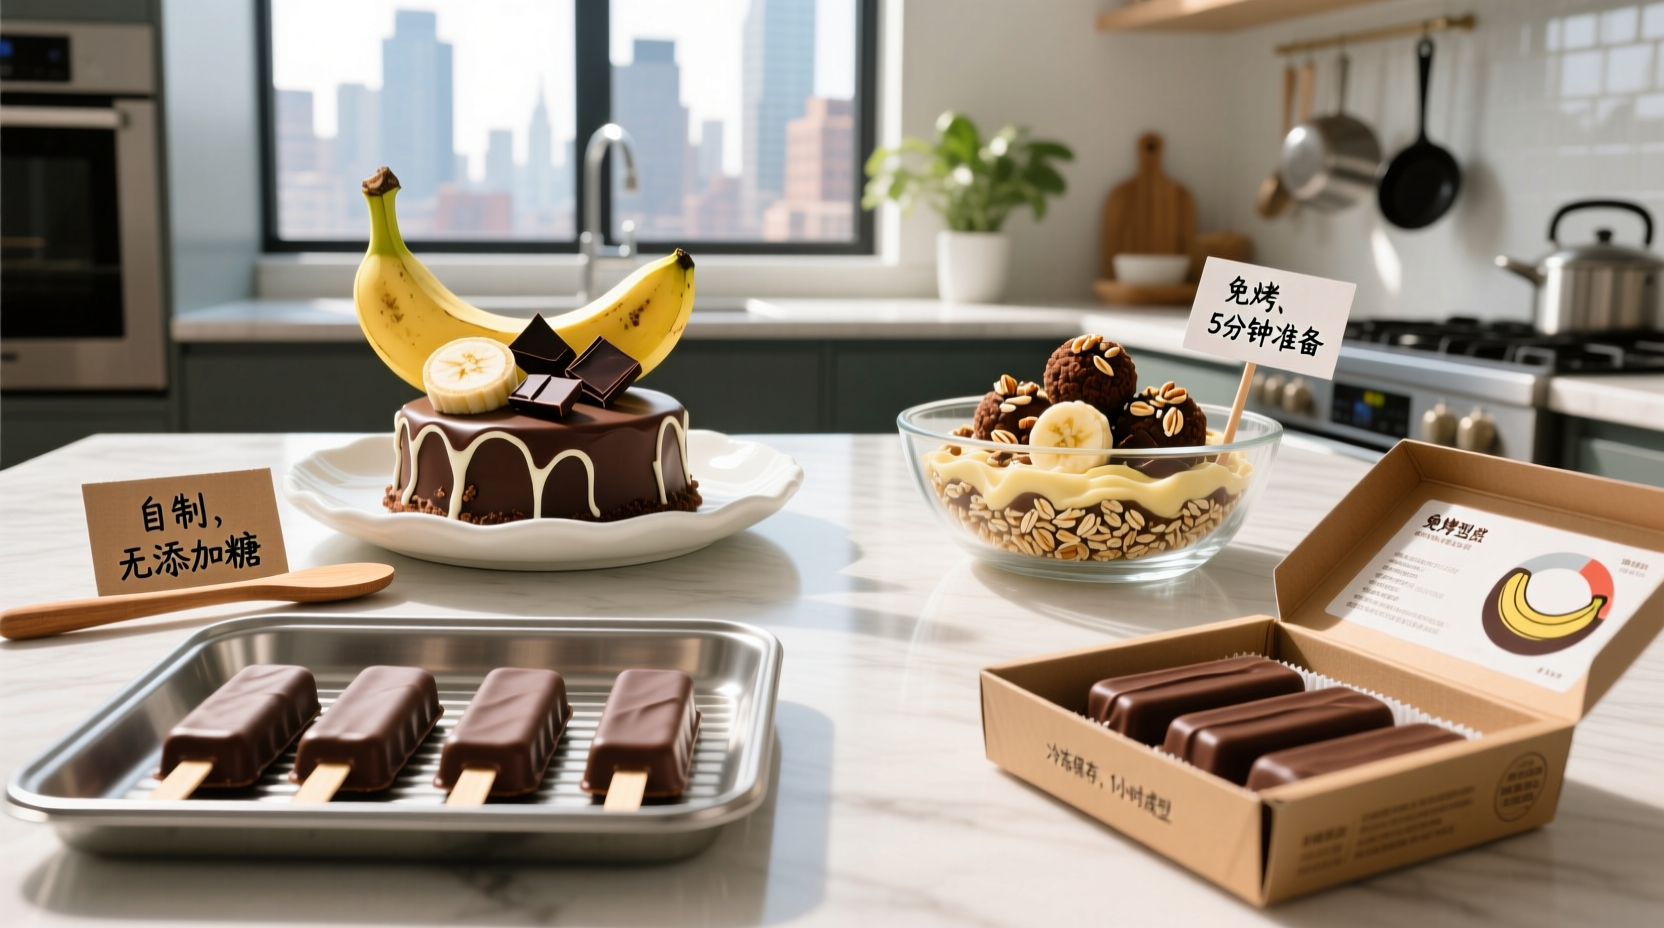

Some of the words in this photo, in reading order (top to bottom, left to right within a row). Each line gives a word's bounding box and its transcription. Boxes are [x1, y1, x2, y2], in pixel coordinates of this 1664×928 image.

[1225, 275, 1283, 314] 免烤、
[1207, 312, 1324, 357] 5分钟准备
[141, 491, 223, 533] 自制，
[119, 531, 262, 582] 无添加糖
